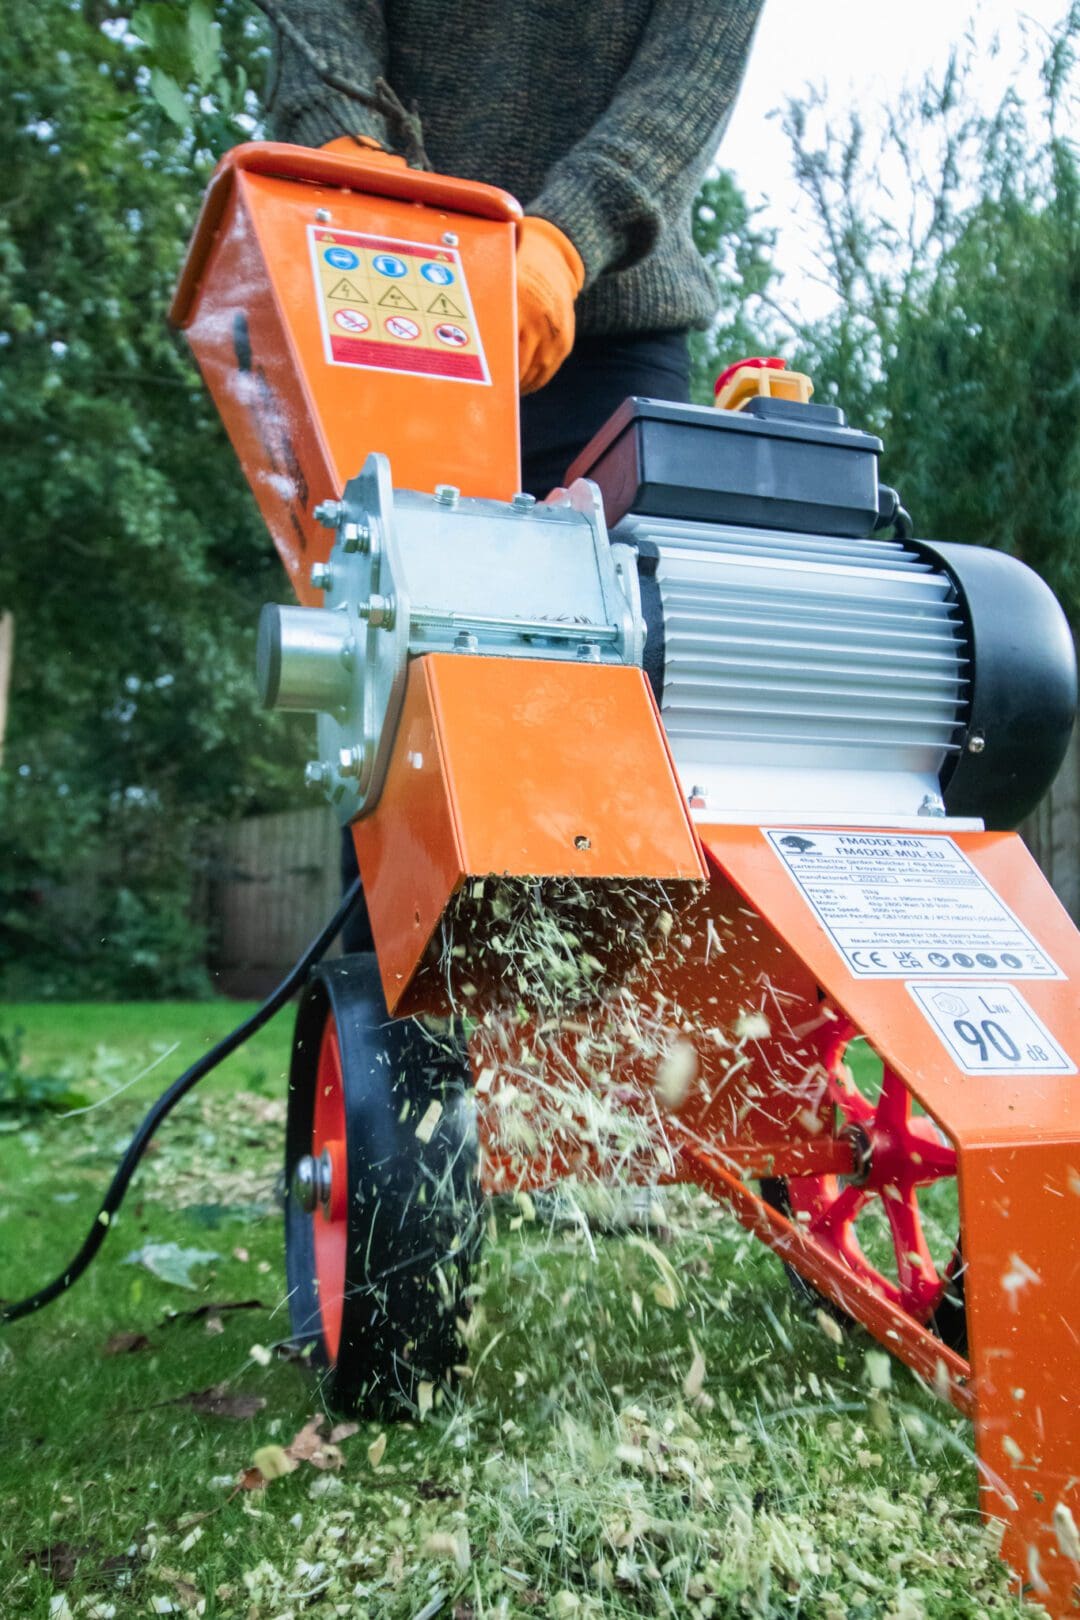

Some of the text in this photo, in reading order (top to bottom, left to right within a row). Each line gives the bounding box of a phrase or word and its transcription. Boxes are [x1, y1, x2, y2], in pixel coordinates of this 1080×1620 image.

[838, 837, 928, 848] FM4DDE-MUL
[835, 847, 945, 859] FM4DDE-MUL-EU
[893, 951, 915, 960] UK
[899, 960, 923, 968] CA
[953, 1019, 1021, 1062] 90
[1026, 1044, 1049, 1062] dB
